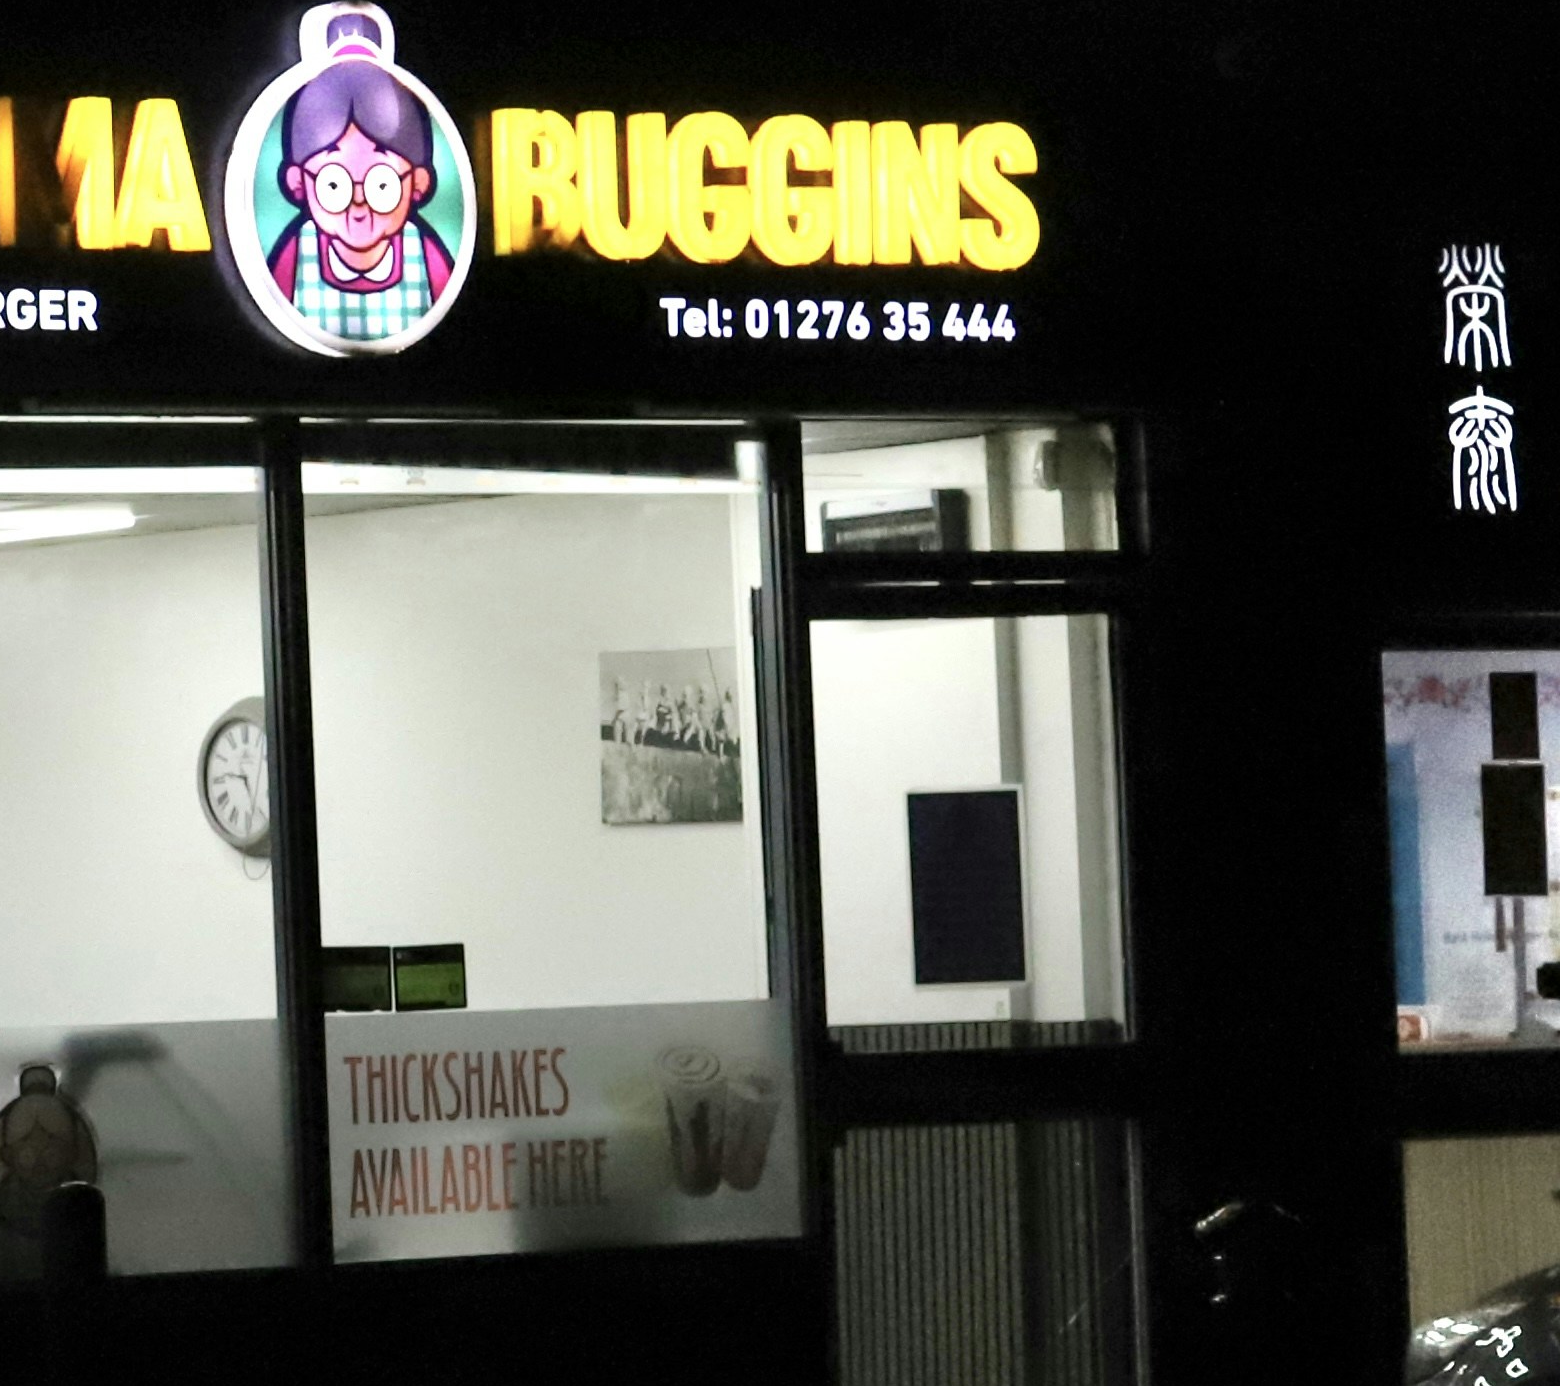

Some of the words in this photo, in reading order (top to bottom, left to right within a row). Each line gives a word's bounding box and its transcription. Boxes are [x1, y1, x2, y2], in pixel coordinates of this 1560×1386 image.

[659, 297, 733, 339] Tel:
[744, 298, 871, 341] 01276
[882, 301, 931, 342] 35
[941, 303, 1017, 343] 444
[343, 1048, 569, 1125] THICKSHAKES
[350, 1142, 516, 1218] AVAILABLE
[527, 1137, 609, 1207] HERE
